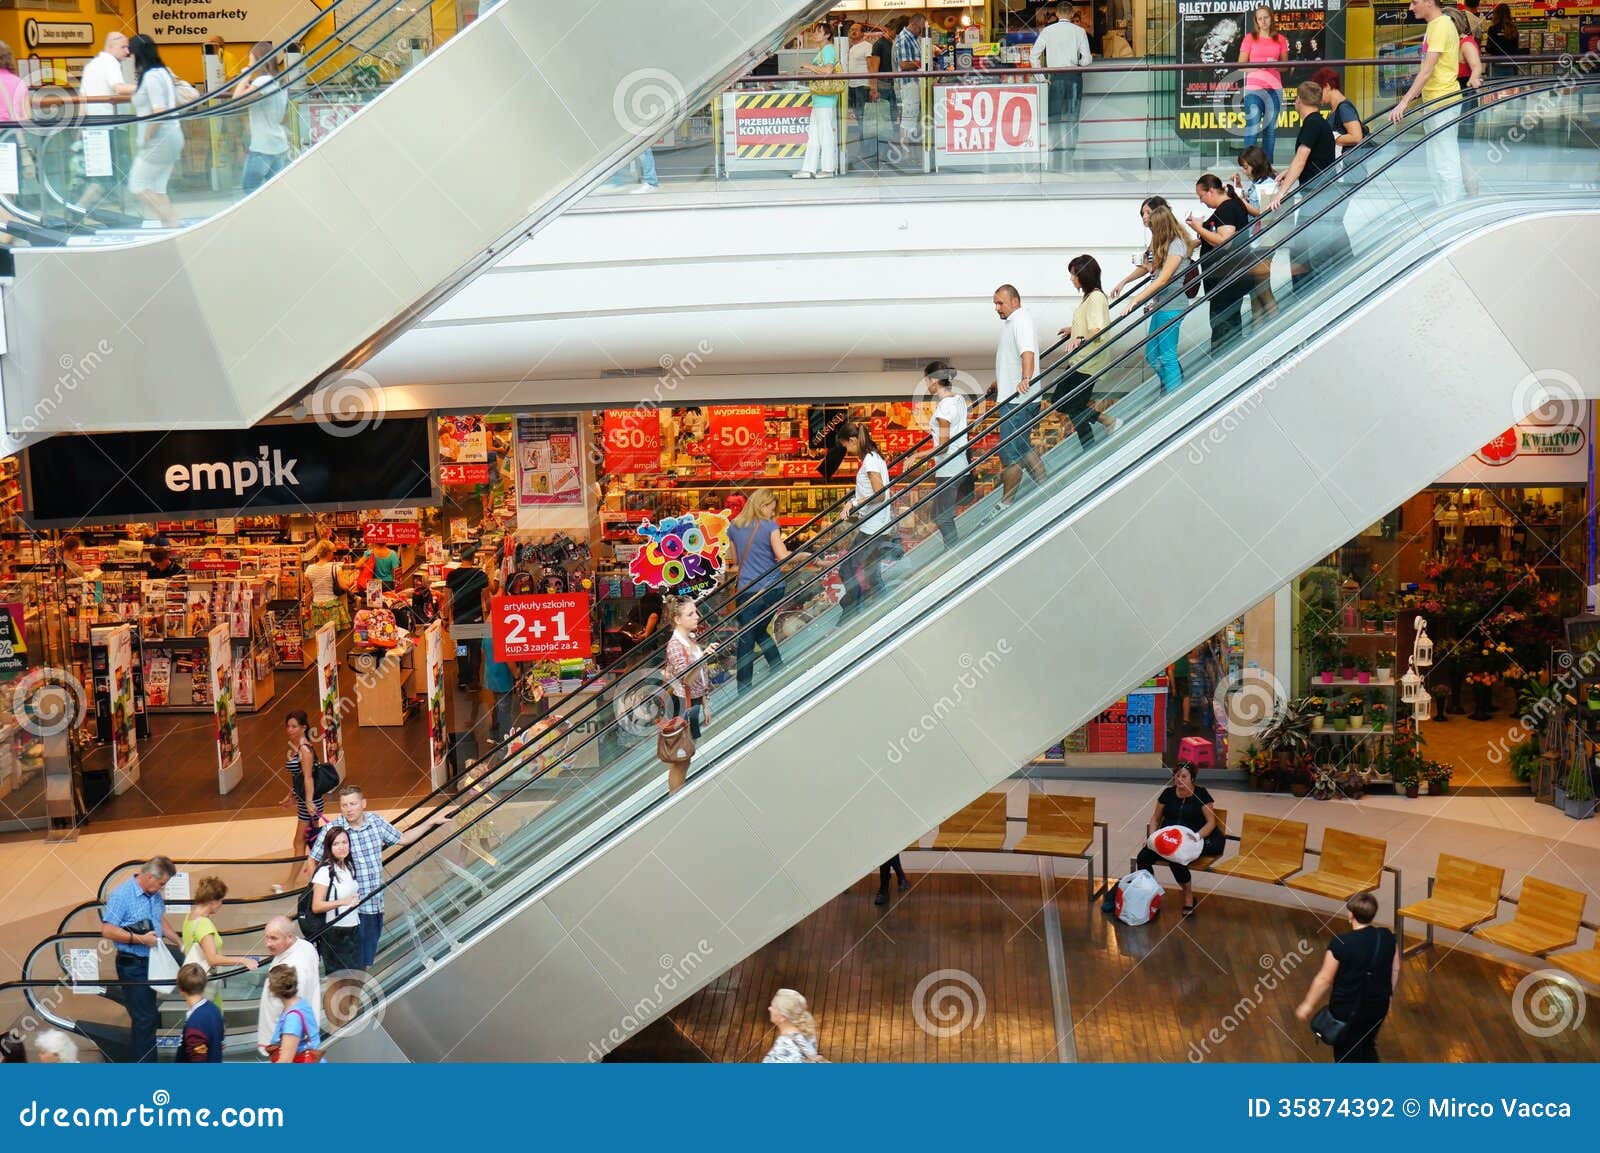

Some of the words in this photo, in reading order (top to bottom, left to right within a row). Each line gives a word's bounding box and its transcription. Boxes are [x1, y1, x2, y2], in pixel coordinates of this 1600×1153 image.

[1178, 1, 1214, 13] BILETY
[1214, 1, 1229, 12] DO
[1229, 0, 1271, 12] NABYCIA
[1272, 0, 1284, 10] W
[1285, 0, 1324, 9] SKLEPIE
[152, 9, 248, 20] elektromarkety
[167, 25, 208, 35] Polsce
[1275, 21, 1325, 31] KELBACK
[953, 91, 994, 127] 50
[738, 116, 798, 126] PRZEBIJAMY
[798, 116, 811, 125] CE
[1179, 111, 1247, 129] NAJLEPS
[739, 124, 810, 136] KONKURENC
[953, 126, 993, 150] RAT
[713, 407, 761, 416] wyprzedaż
[713, 426, 763, 446] -50%
[889, 434, 915, 446] 2+1
[1522, 429, 1581, 447] KWIATÓW
[634, 460, 658, 470] empik
[739, 459, 763, 469] empik
[788, 464, 808, 474] 2+1
[165, 445, 300, 496] empik
[440, 466, 465, 479] 2+1
[395, 509, 413, 517] empik
[366, 523, 395, 538] 2+1
[503, 601, 541, 611] artykuły
[542, 599, 576, 609] szkolne
[503, 611, 570, 644] 2+1
[505, 644, 522, 653] kup
[523, 644, 529, 652] 3
[530, 642, 559, 652] zapłać
[572, 641, 578, 649] 2
[1094, 711, 1152, 725] ik.com
